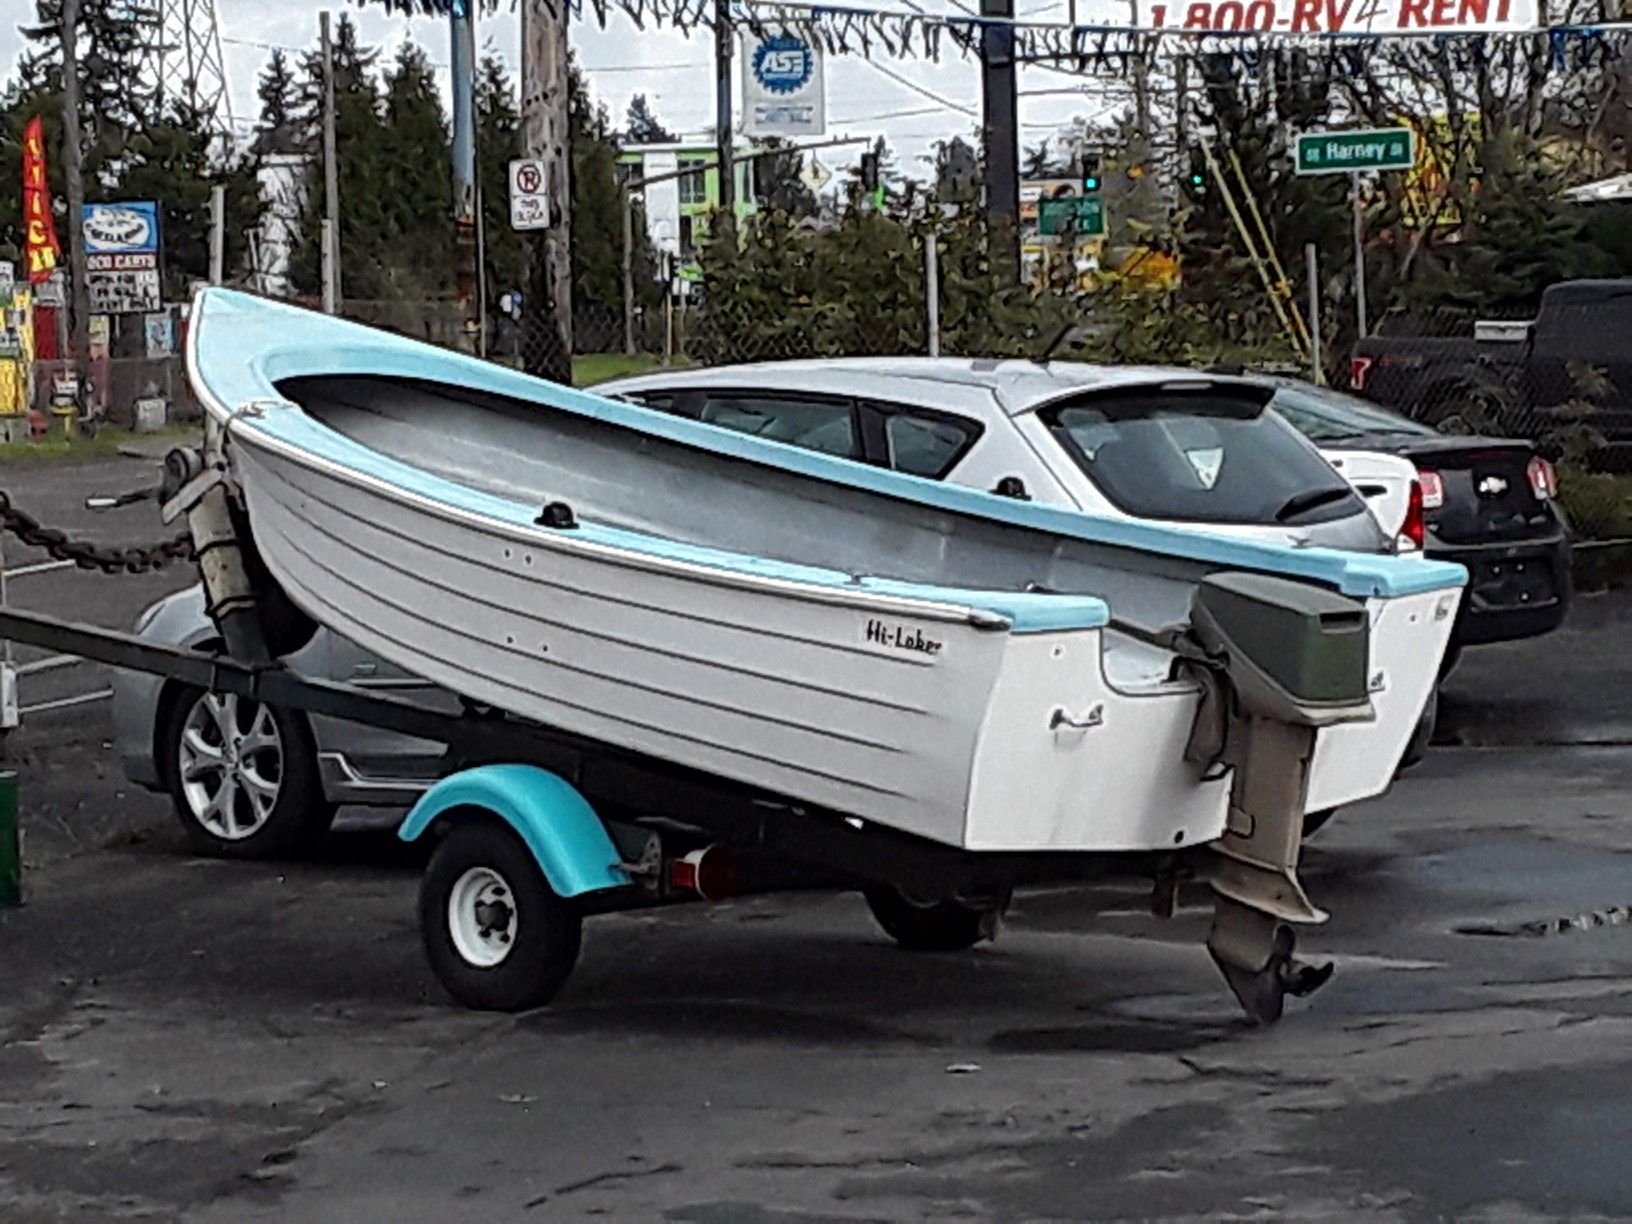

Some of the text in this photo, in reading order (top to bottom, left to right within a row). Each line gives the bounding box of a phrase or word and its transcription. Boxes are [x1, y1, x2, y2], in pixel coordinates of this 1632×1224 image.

[1396, 0, 1511, 28] RENT
[760, 51, 805, 73] ASE
[1326, 141, 1386, 161] Harney
